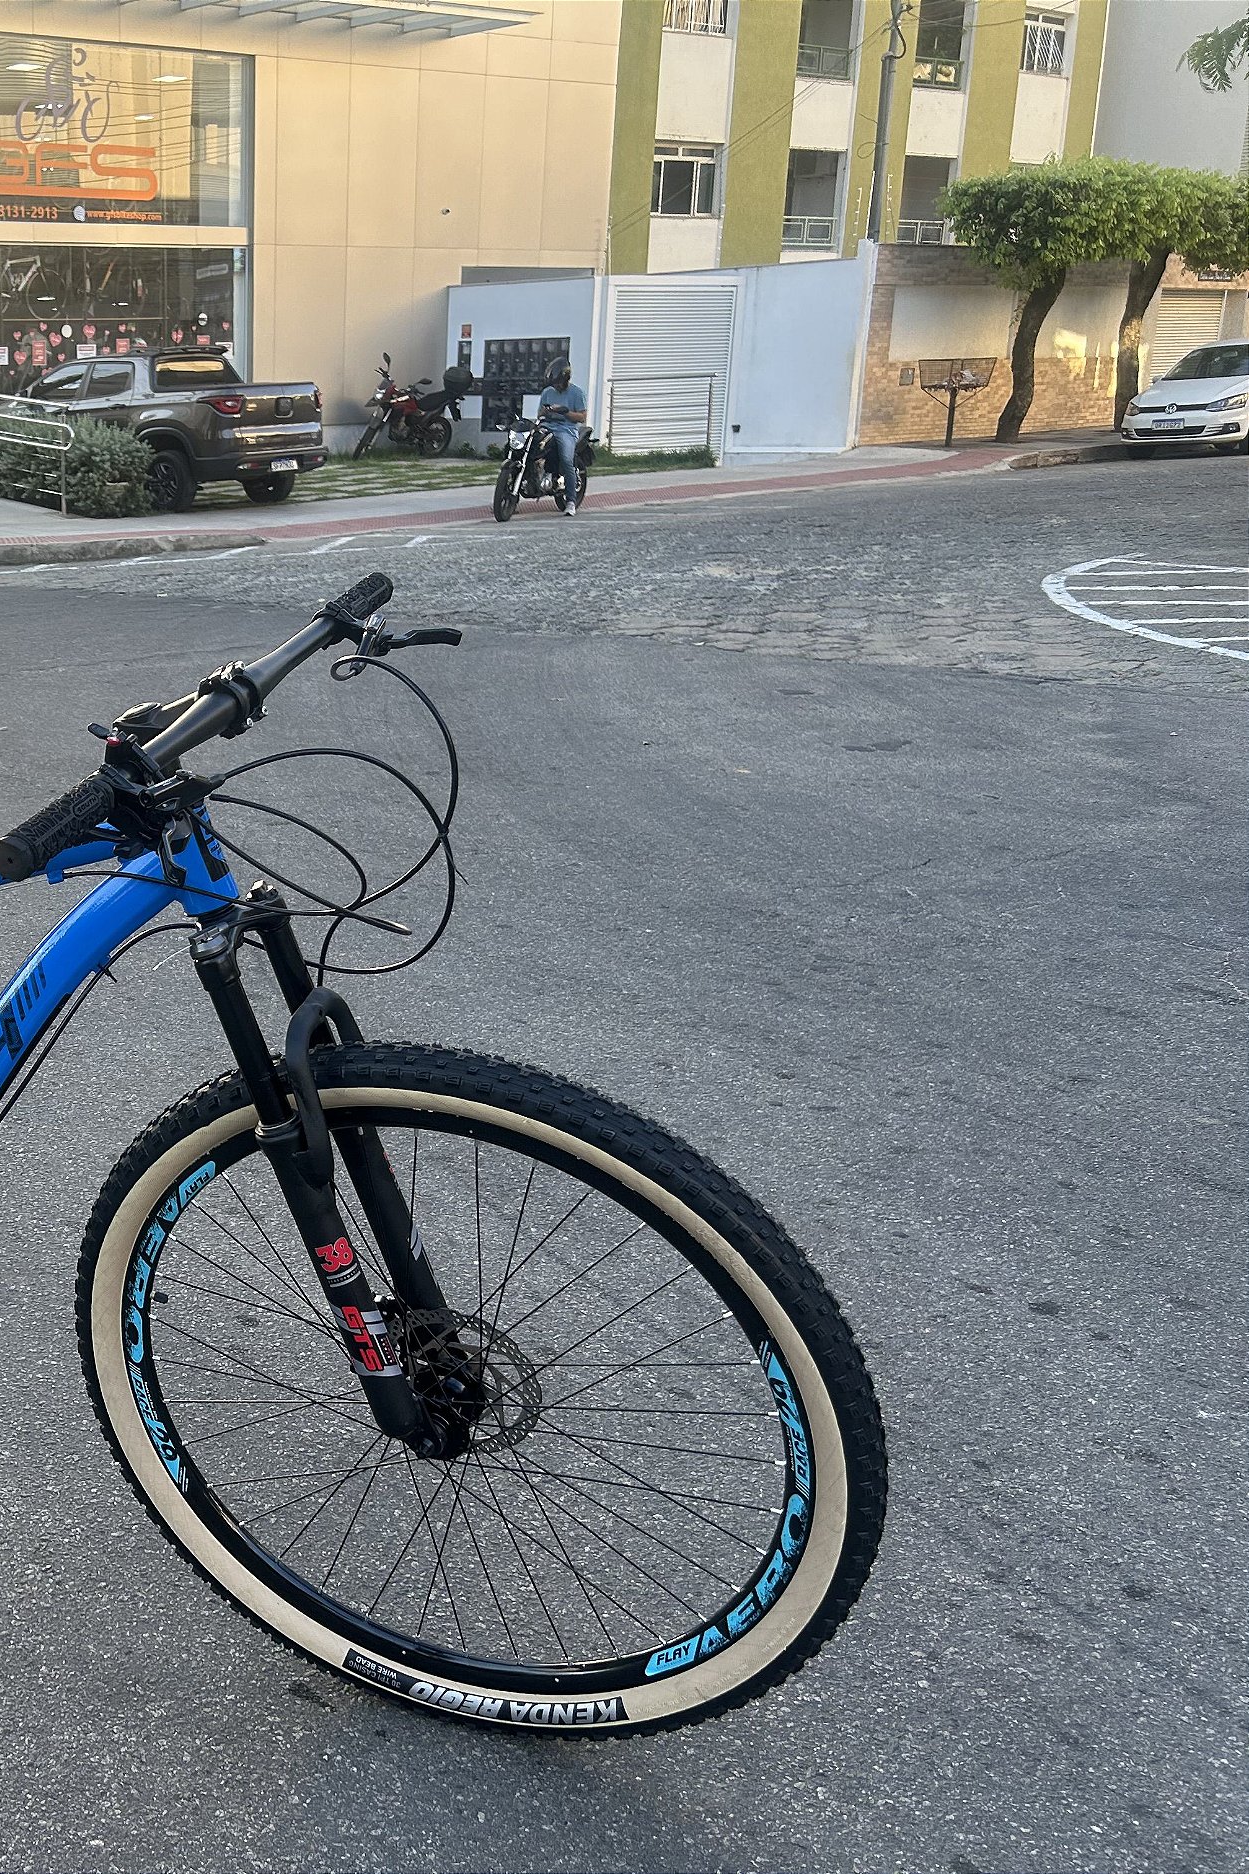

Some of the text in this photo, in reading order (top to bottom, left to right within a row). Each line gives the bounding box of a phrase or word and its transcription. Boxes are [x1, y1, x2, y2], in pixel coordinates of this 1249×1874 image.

[183, 1171, 211, 1200] FLAY
[314, 1236, 354, 1273] 38
[123, 1193, 179, 1363] AERO
[342, 1306, 384, 1372] GTS
[792, 1427, 810, 1482] RACE
[699, 1494, 808, 1657] AERO
[355, 1655, 398, 1680] WIRE BEAD
[656, 1643, 692, 1666] FLAY
[408, 1681, 617, 1724] KENDA REGIO
